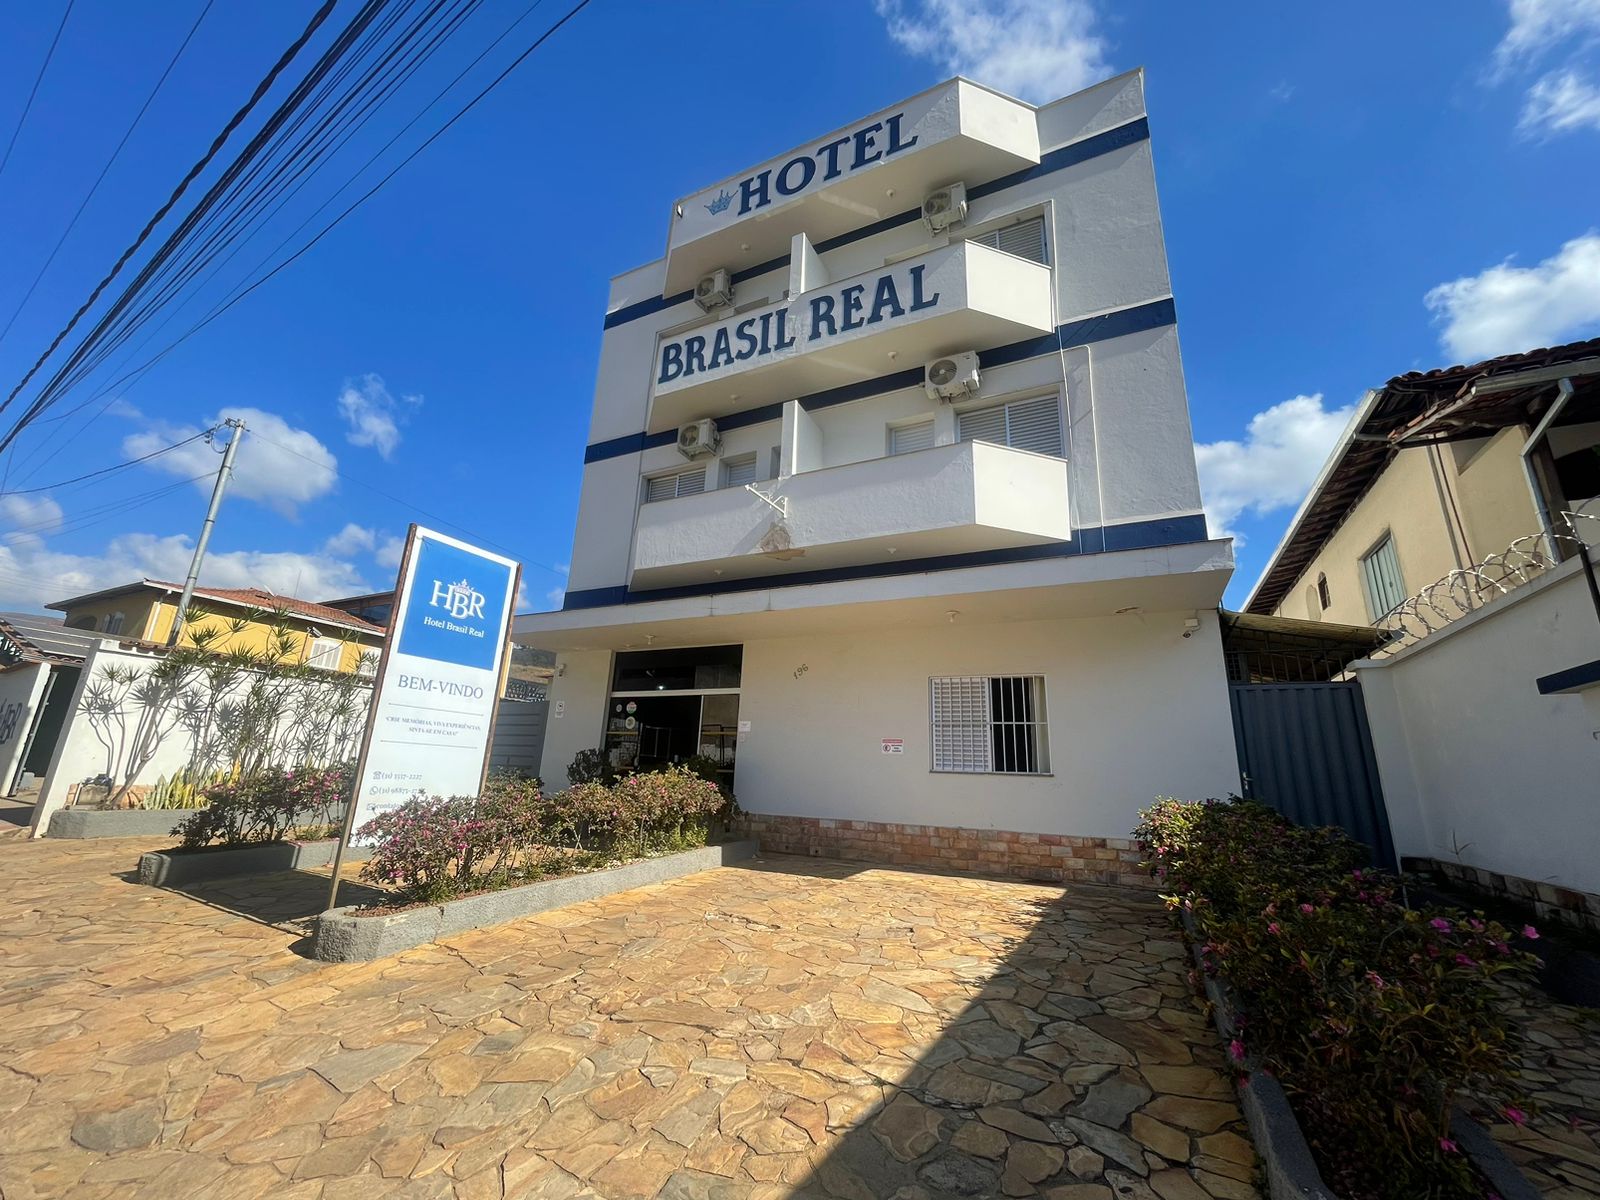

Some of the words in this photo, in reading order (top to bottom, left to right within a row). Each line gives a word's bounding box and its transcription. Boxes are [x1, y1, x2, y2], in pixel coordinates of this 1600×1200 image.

[737, 112, 919, 216] HOTEL
[658, 307, 796, 385] BRASIL
[808, 263, 940, 342] REAL
[428, 579, 486, 620] HBR
[423, 616, 446, 629] Hotel
[446, 621, 468, 634] Brasil
[468, 627, 485, 638] Real
[397, 674, 484, 700] BEM-VINDO
[793, 663, 809, 680] 196
